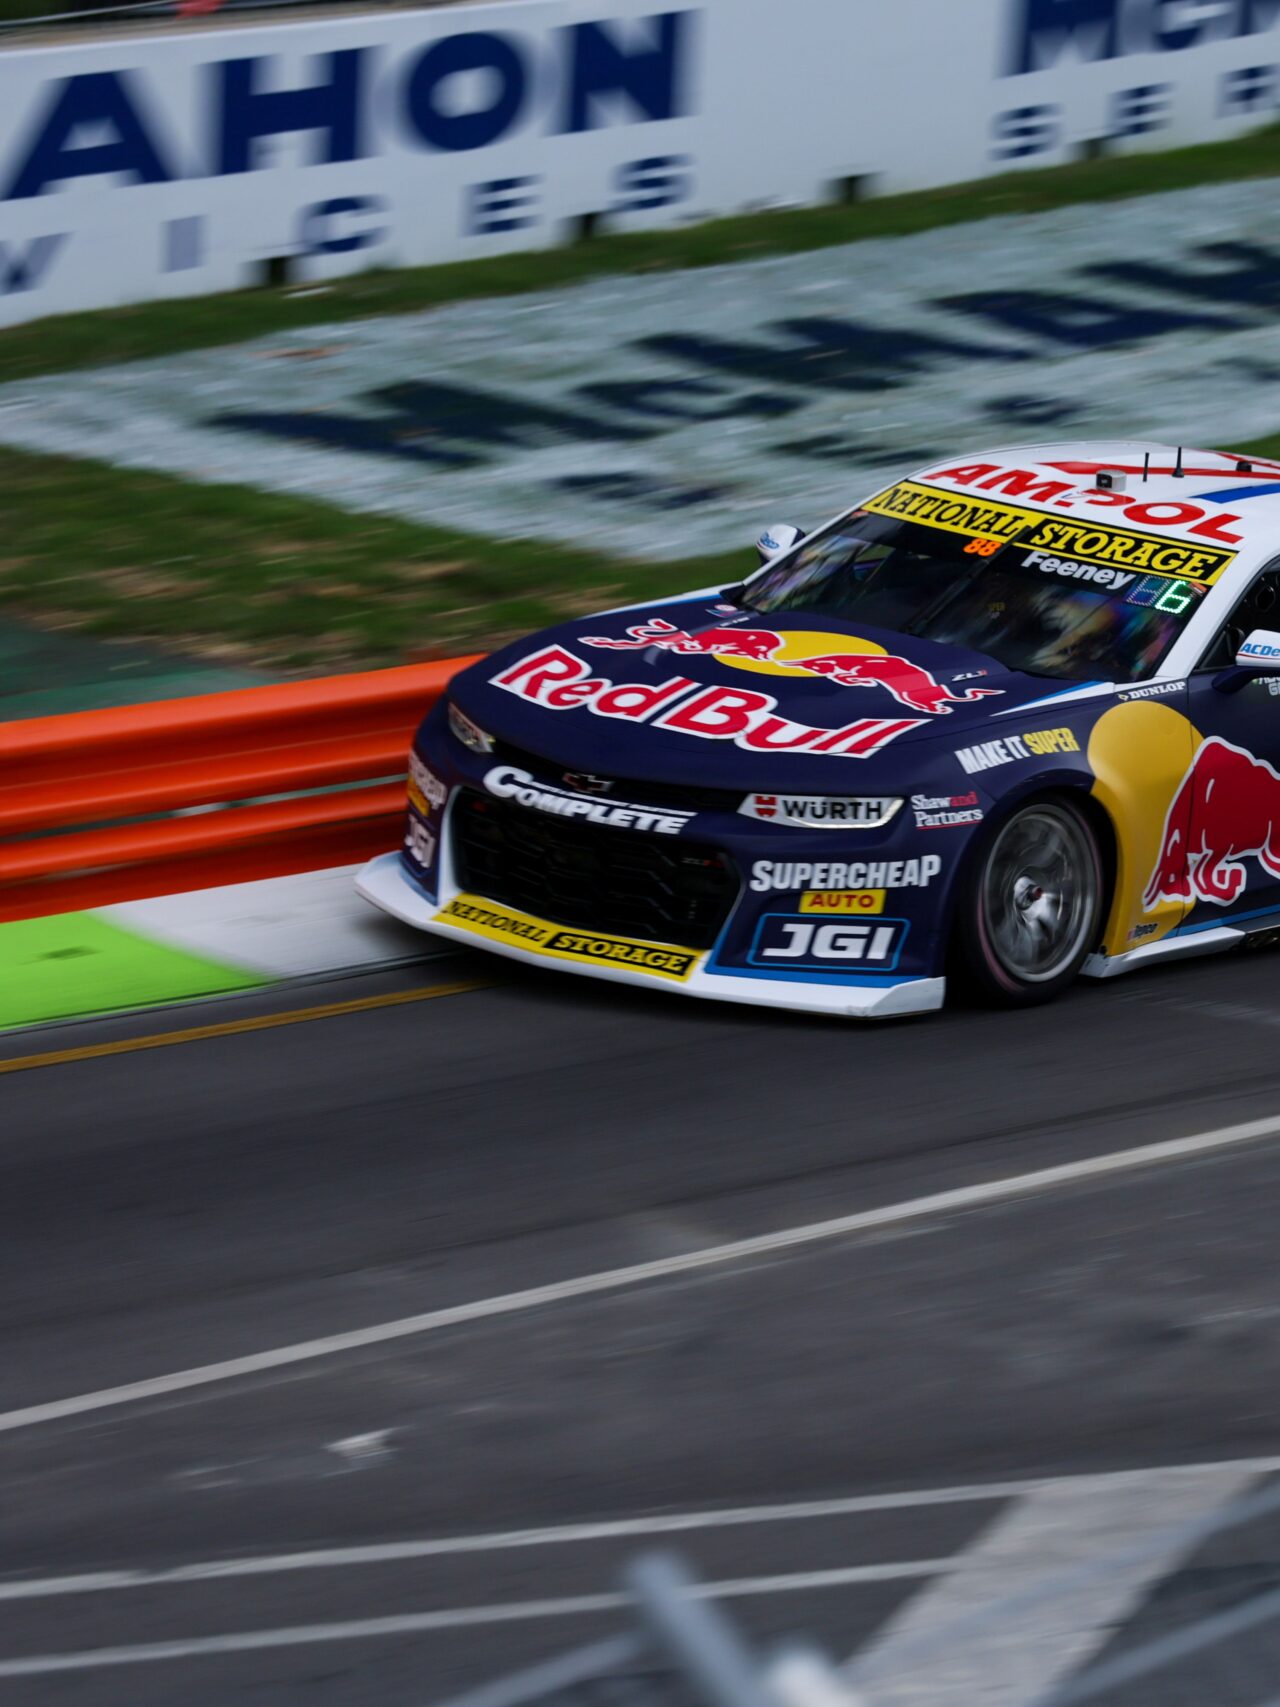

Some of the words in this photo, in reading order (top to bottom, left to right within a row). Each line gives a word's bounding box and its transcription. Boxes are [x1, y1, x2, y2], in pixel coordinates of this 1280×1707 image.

[874, 488, 1032, 539] NATIONAL
[1030, 522, 1217, 579] STORAGE
[963, 538, 1002, 558] 88
[1021, 551, 1138, 590] Feeney
[1128, 681, 1186, 699] DUNLOP
[954, 739, 1014, 775] MAKE
[1003, 735, 1031, 760] IT
[1023, 727, 1081, 755] SUPER
[482, 765, 690, 835] COMPLETE
[911, 794, 951, 811] Shaw
[914, 808, 984, 828] Partners
[750, 855, 942, 892] SUPERCHEAP
[808, 894, 876, 908] AUTO
[441, 901, 550, 942] NATIONAL
[554, 934, 689, 972] STORAGE
[762, 923, 896, 960] JGI
